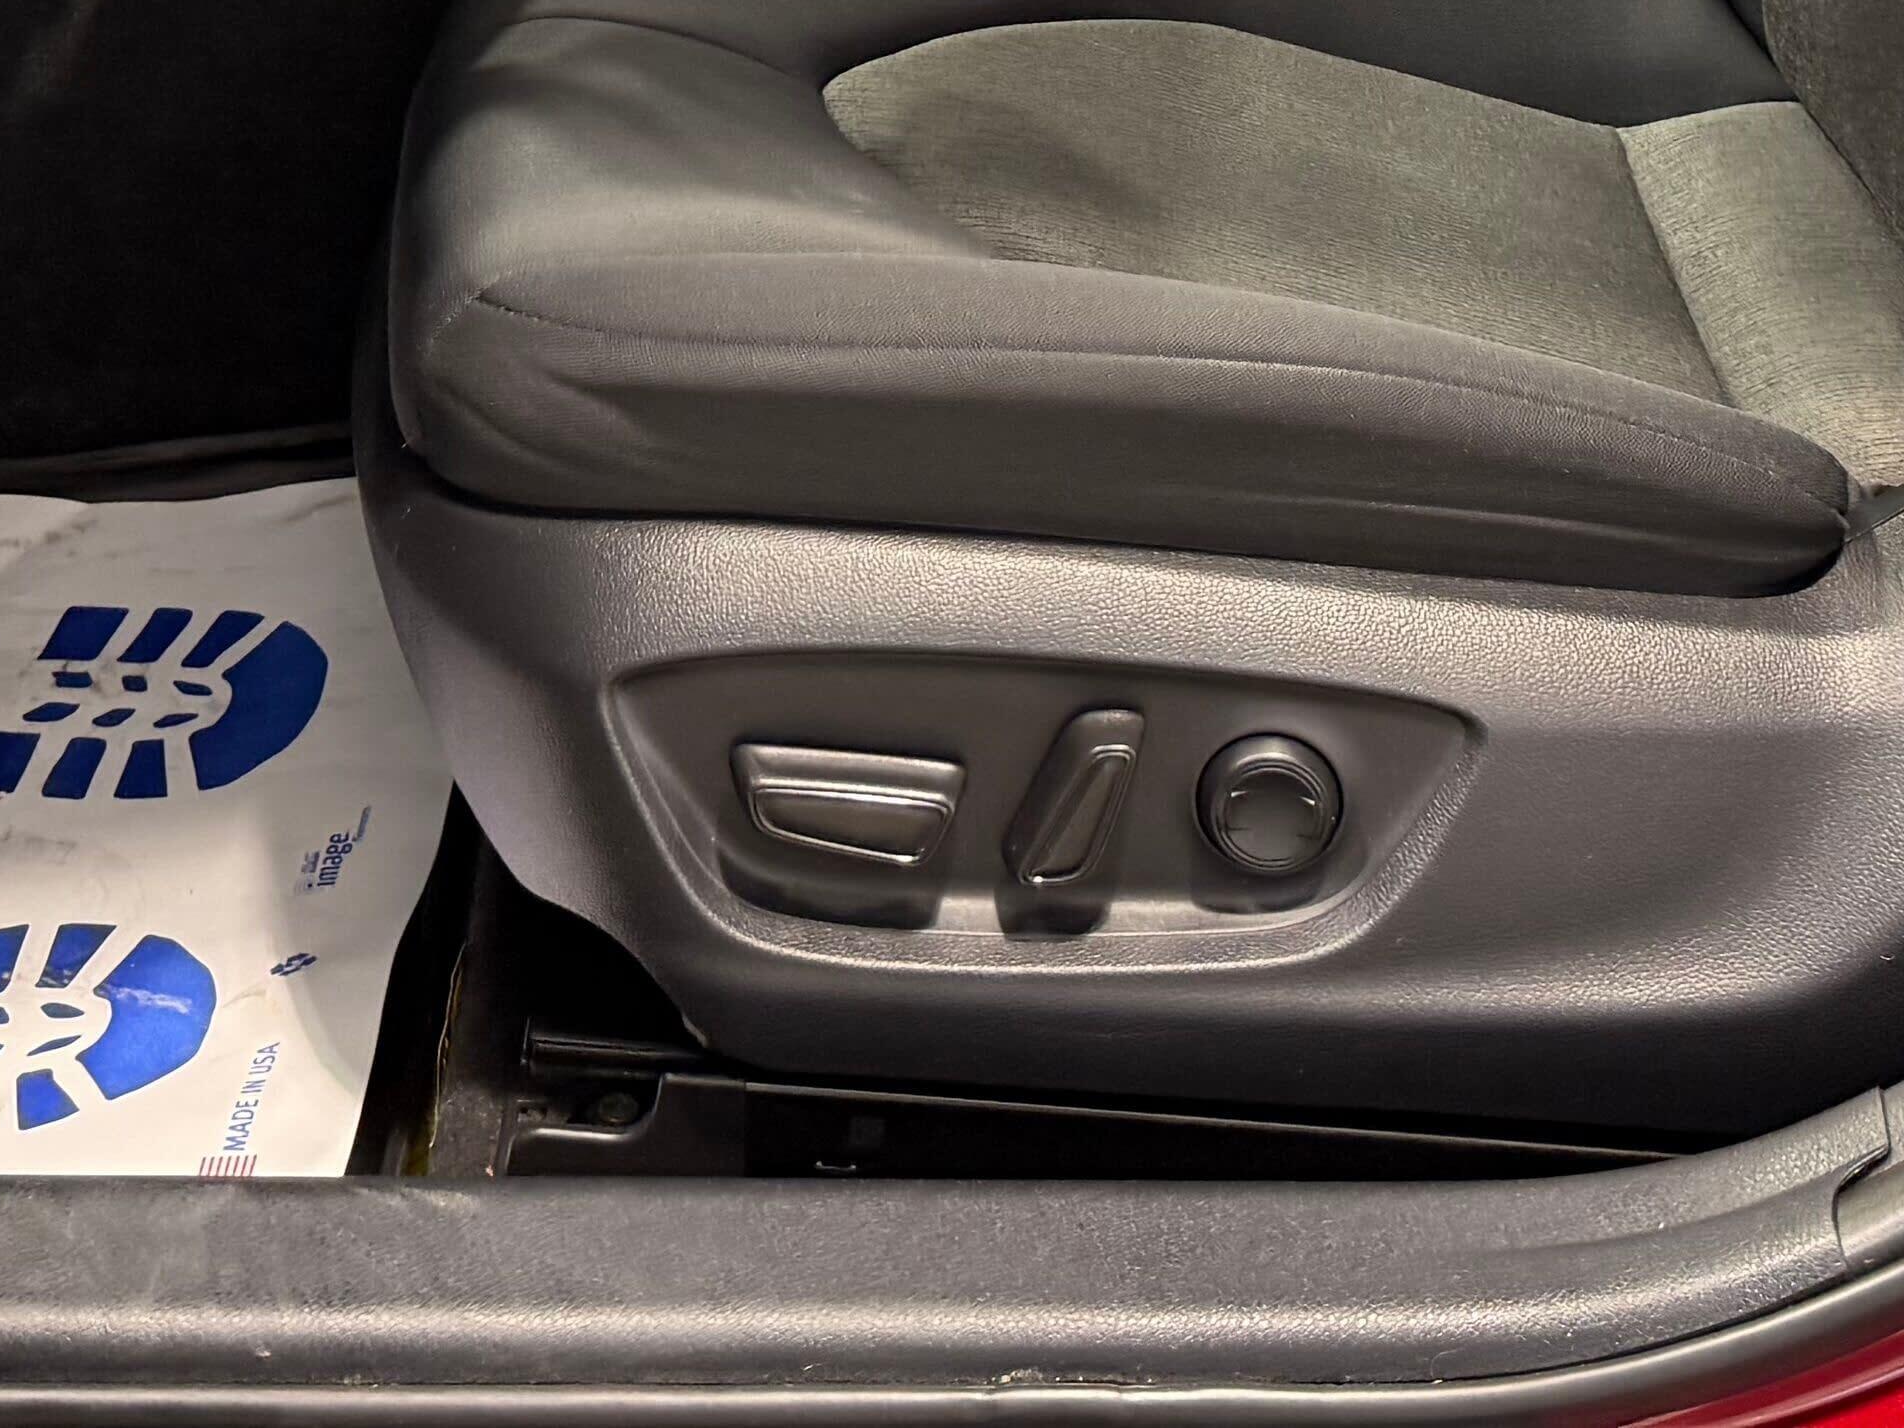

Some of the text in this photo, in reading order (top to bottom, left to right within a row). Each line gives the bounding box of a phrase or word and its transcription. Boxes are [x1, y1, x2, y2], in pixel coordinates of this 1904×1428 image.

[316, 832, 353, 887] image
[223, 1042, 281, 1151] MADE IN USA
